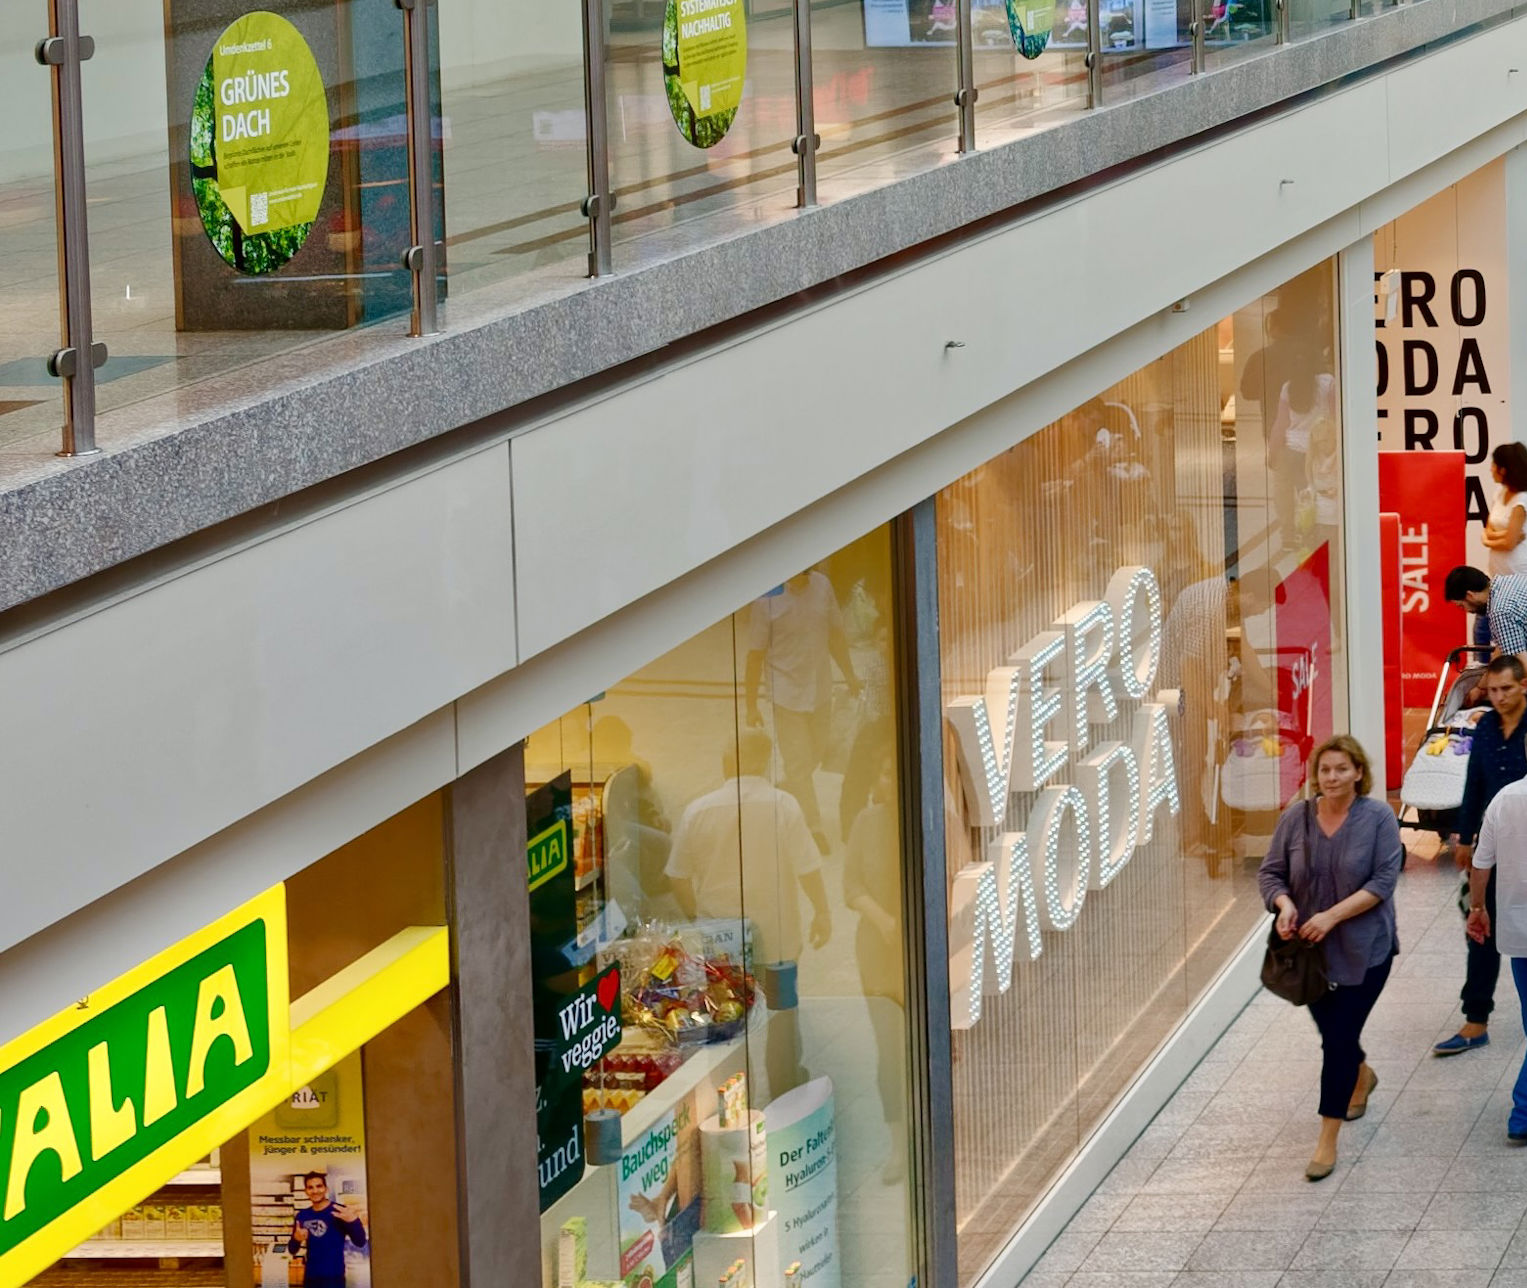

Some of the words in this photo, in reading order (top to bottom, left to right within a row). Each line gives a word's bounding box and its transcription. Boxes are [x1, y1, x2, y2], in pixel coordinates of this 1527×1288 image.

[681, 12, 731, 39] NACHHALTIG
[220, 70, 290, 106] GRÜNES
[222, 108, 270, 142] DACH
[1402, 521, 1428, 613] SALE
[962, 566, 1162, 825] VERO
[966, 703, 1181, 1025] MODA
[558, 993, 598, 1041] Wir
[560, 1014, 622, 1074] veggie.
[0, 964, 253, 1221] ALIA
[285, 1088, 328, 1103] RIÄT
[259, 1135, 301, 1144] Messbar
[263, 1144, 297, 1155] jünger
[621, 1101, 690, 1182] Bauchspeck
[780, 1146, 803, 1167] Der
[641, 1157, 668, 1192] weg
